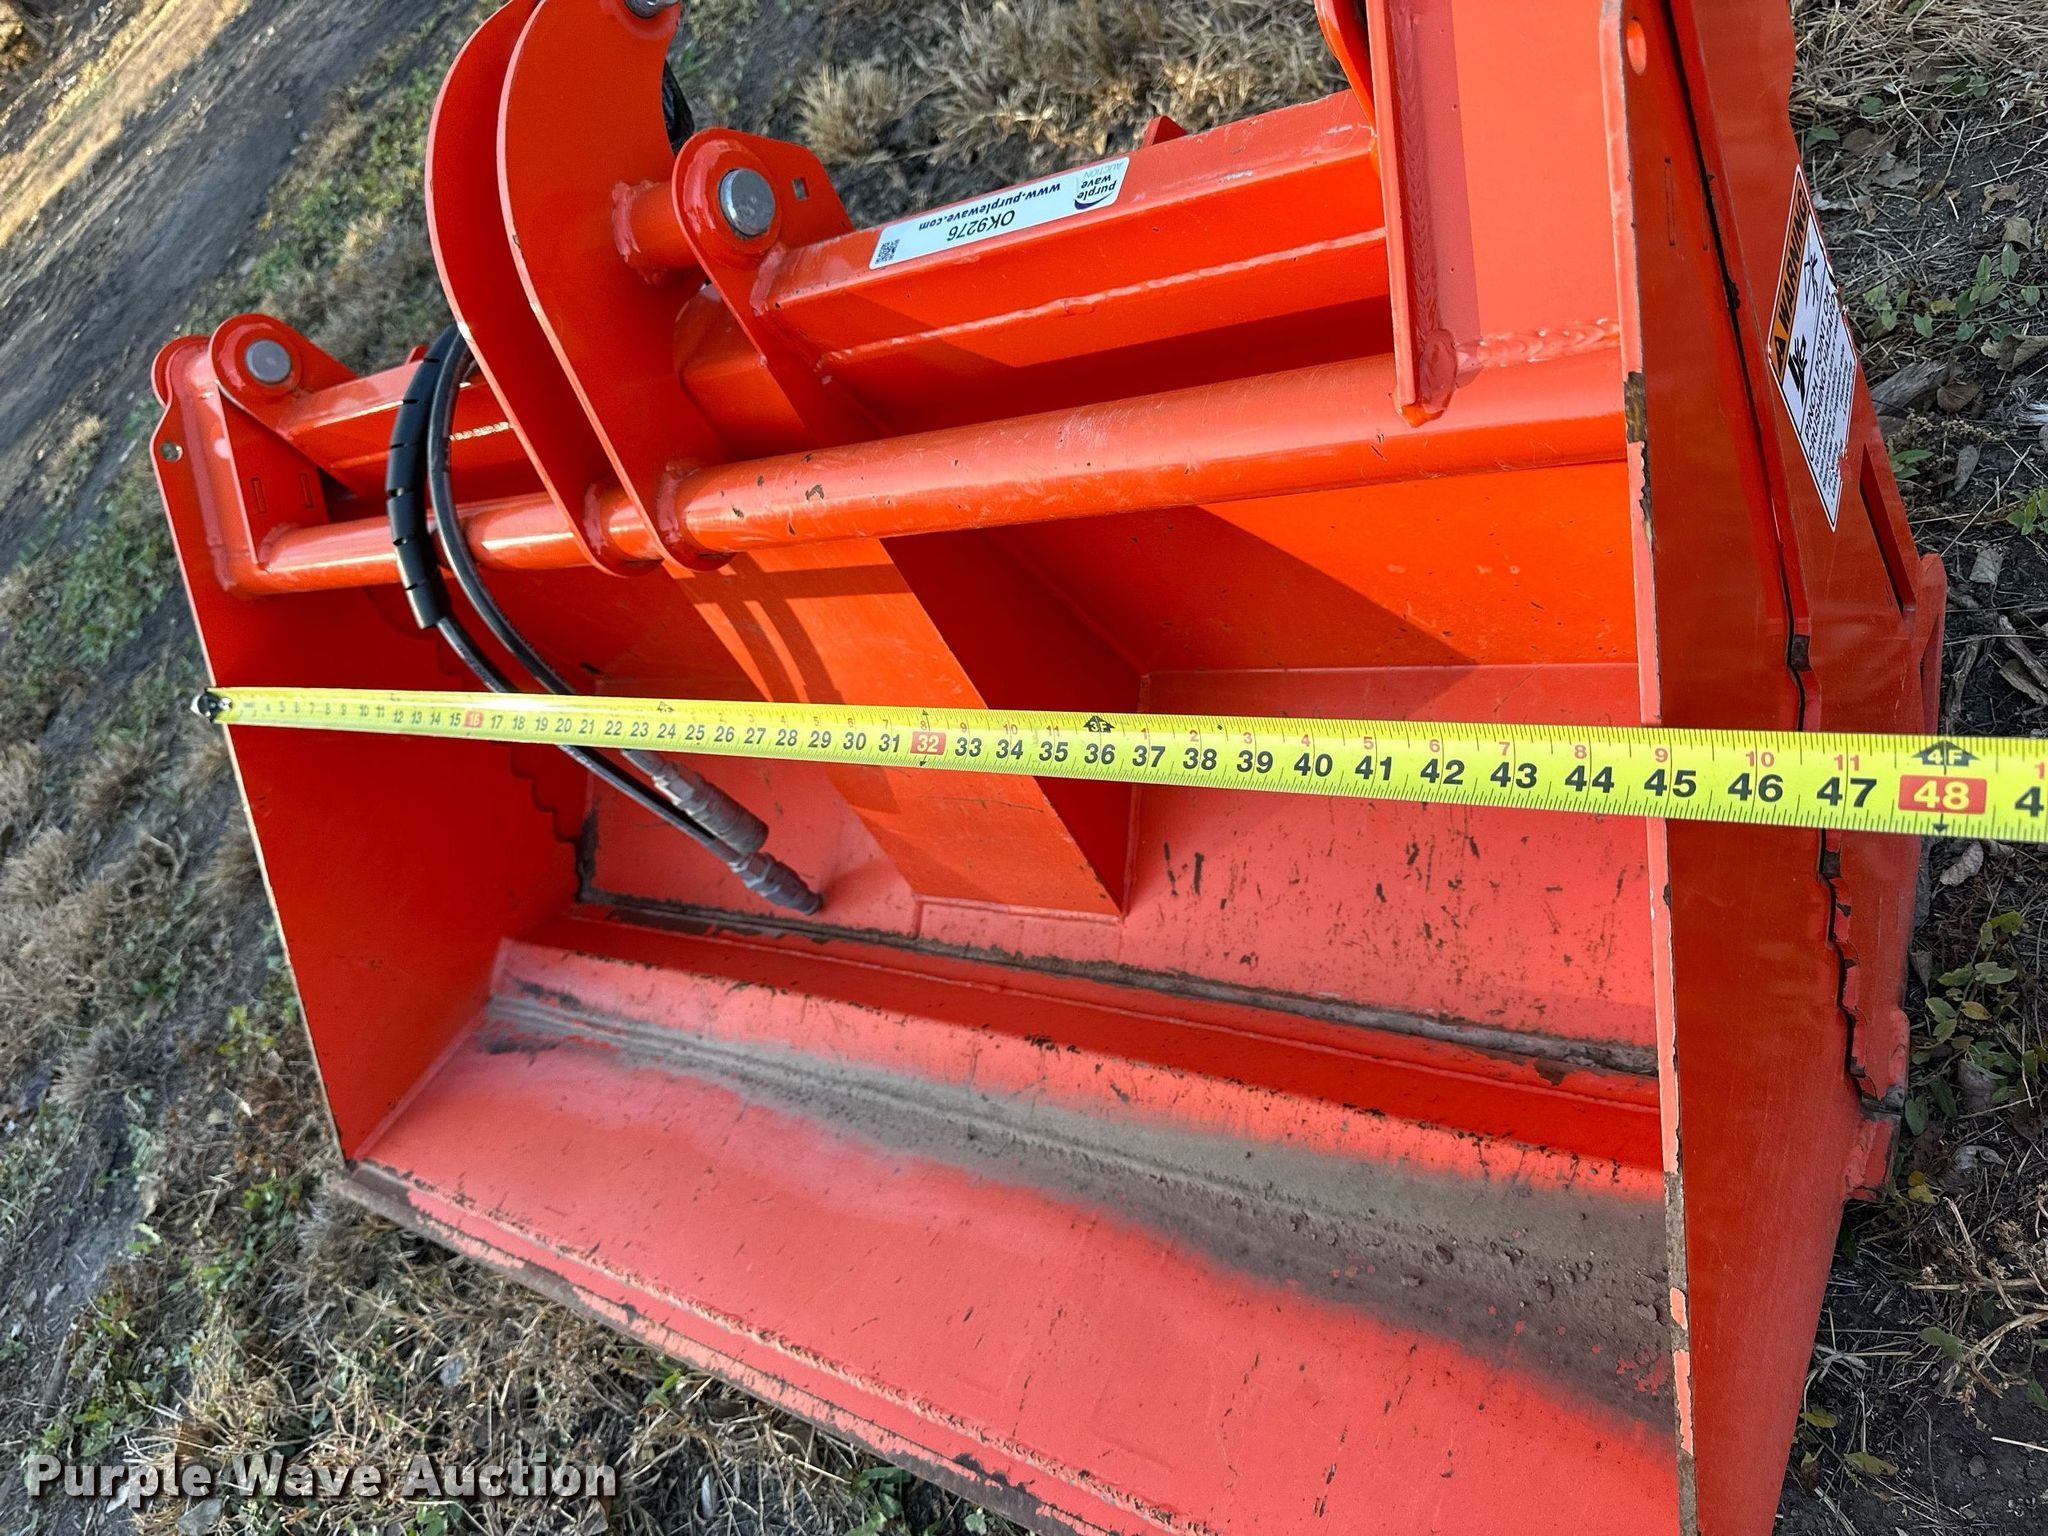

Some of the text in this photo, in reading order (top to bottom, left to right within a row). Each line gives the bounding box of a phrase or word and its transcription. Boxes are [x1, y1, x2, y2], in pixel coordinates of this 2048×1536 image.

[1081, 174, 1111, 189] wave
[1083, 162, 1123, 178] AUCTION
[1077, 180, 1117, 200] purple
[919, 183, 1061, 231] www.purplewave.com
[947, 210, 1015, 242] OK9276
[1778, 188, 1807, 335] WARNING
[1804, 379, 1818, 442] PINCH
[1814, 320, 1827, 373] POINT
[1823, 285, 1832, 316] OR
[1809, 365, 1827, 462] CRUSHING
[1822, 291, 1837, 366] HAZARD
[882, 719, 889, 729] 7
[920, 720, 927, 731] 8
[960, 722, 967, 733] 9
[1003, 723, 1018, 735] 10
[1047, 725, 1060, 737] 11
[1090, 721, 1107, 733] 3F
[359, 704, 369, 717] 10
[376, 705, 385, 718] 11
[393, 710, 404, 724] 12
[411, 711, 422, 724] 13
[430, 712, 441, 726] 14
[450, 713, 461, 727] 15
[469, 712, 480, 726] 16
[491, 715, 503, 729] 17
[513, 716, 525, 730] 18
[535, 717, 548, 731] 19
[555, 718, 572, 733] 20
[579, 719, 594, 734] 21
[604, 720, 623, 736] 22
[630, 721, 649, 738] 23
[657, 722, 676, 739] 24
[685, 724, 705, 741] 25
[714, 725, 735, 743] 26
[744, 727, 766, 745] 27
[776, 729, 798, 747] 28
[808, 730, 832, 749] 29
[843, 732, 867, 751] 30
[878, 733, 900, 752] 31
[916, 735, 938, 753] 32
[955, 737, 982, 757] 33
[995, 739, 1024, 760] 34
[1038, 740, 1069, 762] 35
[1084, 743, 1116, 765] 36
[1132, 745, 1166, 768] 37
[1182, 747, 1217, 770] 38
[1236, 750, 1273, 774] 39
[1293, 752, 1333, 777] 40
[1355, 755, 1392, 781] 41
[1420, 758, 1465, 785] 42
[1490, 761, 1537, 789] 43
[1564, 765, 1614, 793] 44
[1643, 769, 1696, 797] 45
[1727, 773, 1784, 803] 46
[1816, 776, 1877, 808] 47
[1913, 780, 1971, 811] 48
[1140, 727, 1860, 772] 1 2 3 4 5 6 7 8 9 10 11
[1927, 750, 1964, 764] 4F
[2034, 762, 2045, 779] 1
